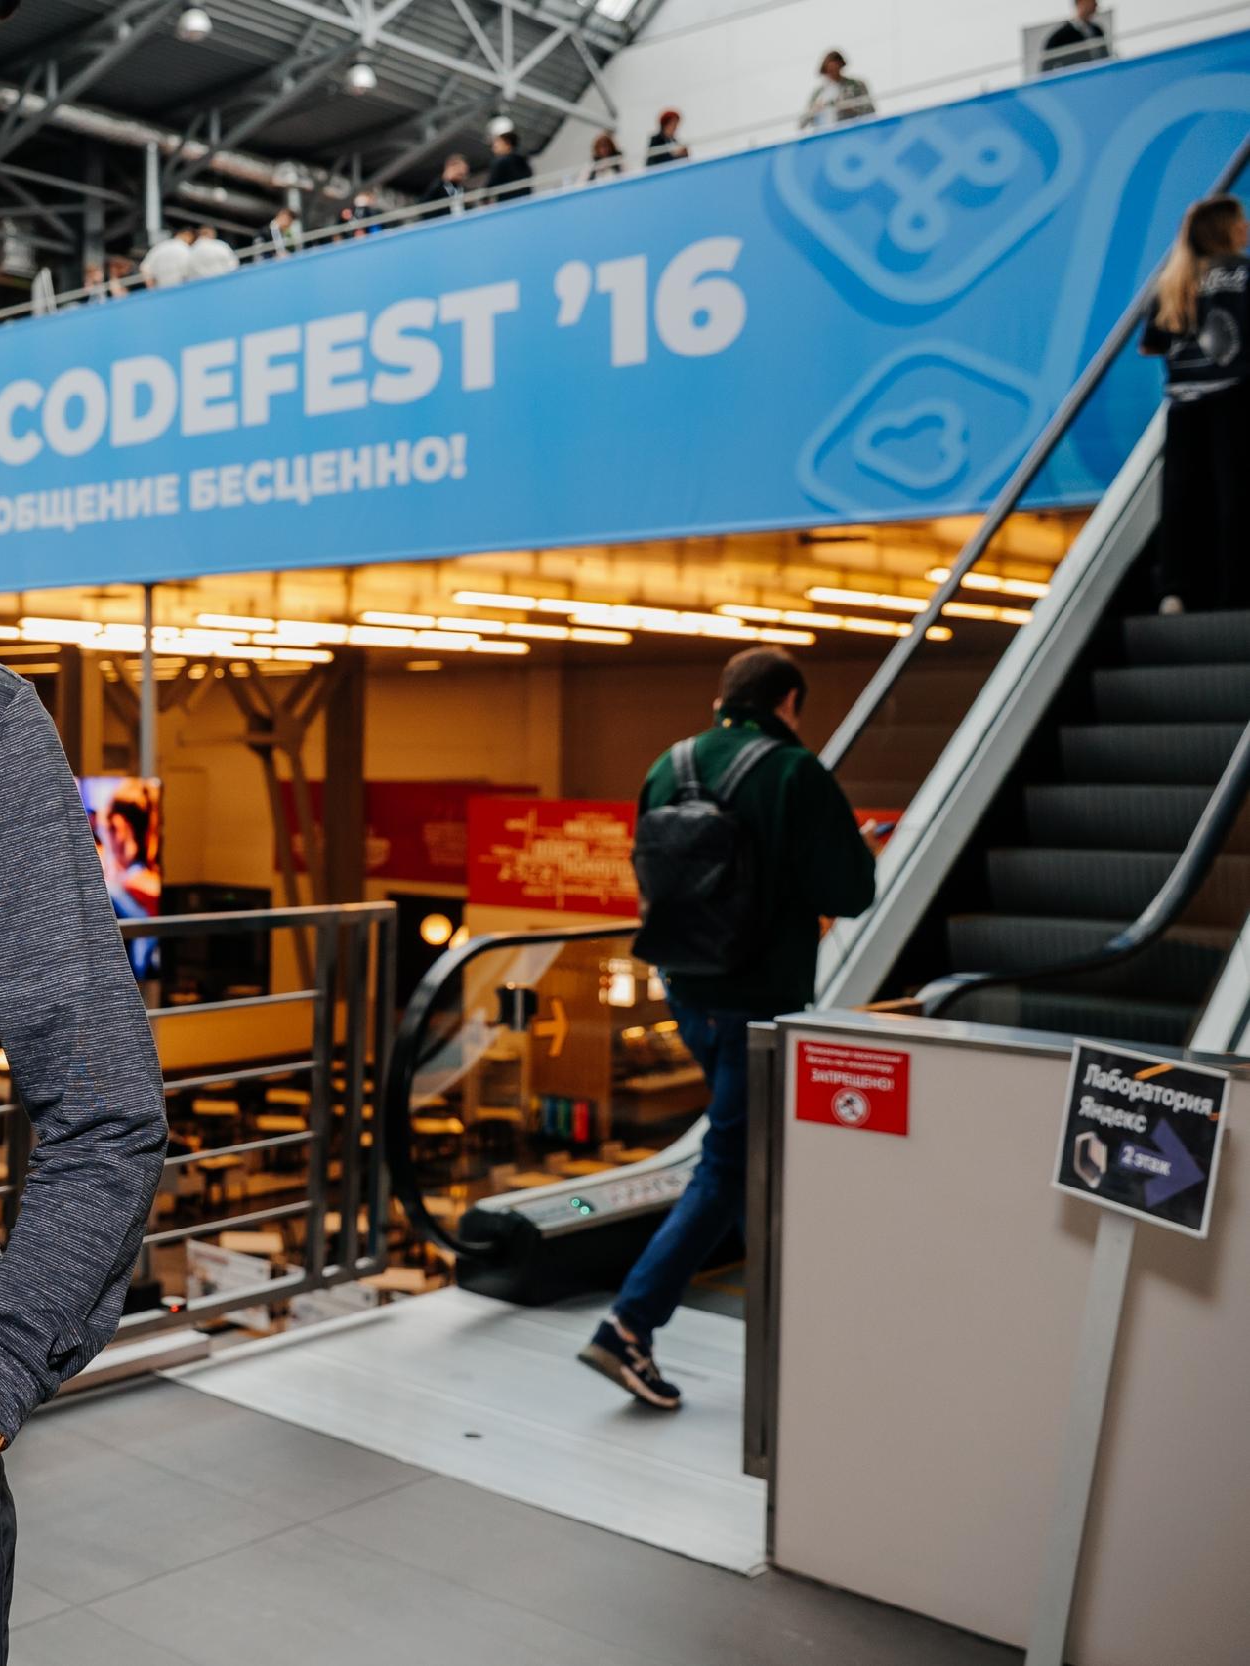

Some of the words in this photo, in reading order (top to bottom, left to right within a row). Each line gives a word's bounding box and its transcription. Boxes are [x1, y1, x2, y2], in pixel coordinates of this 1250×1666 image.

[189, 433, 467, 510] БЕСЦЕННО!
[811, 1067, 895, 1091] ЗАПРЕЩЕНО!
[1083, 1063, 1214, 1116] Лаборатория
[1078, 1095, 1147, 1133] Яндекс
[1121, 1145, 1135, 1165] 2
[1133, 1153, 1173, 1176] этаж
